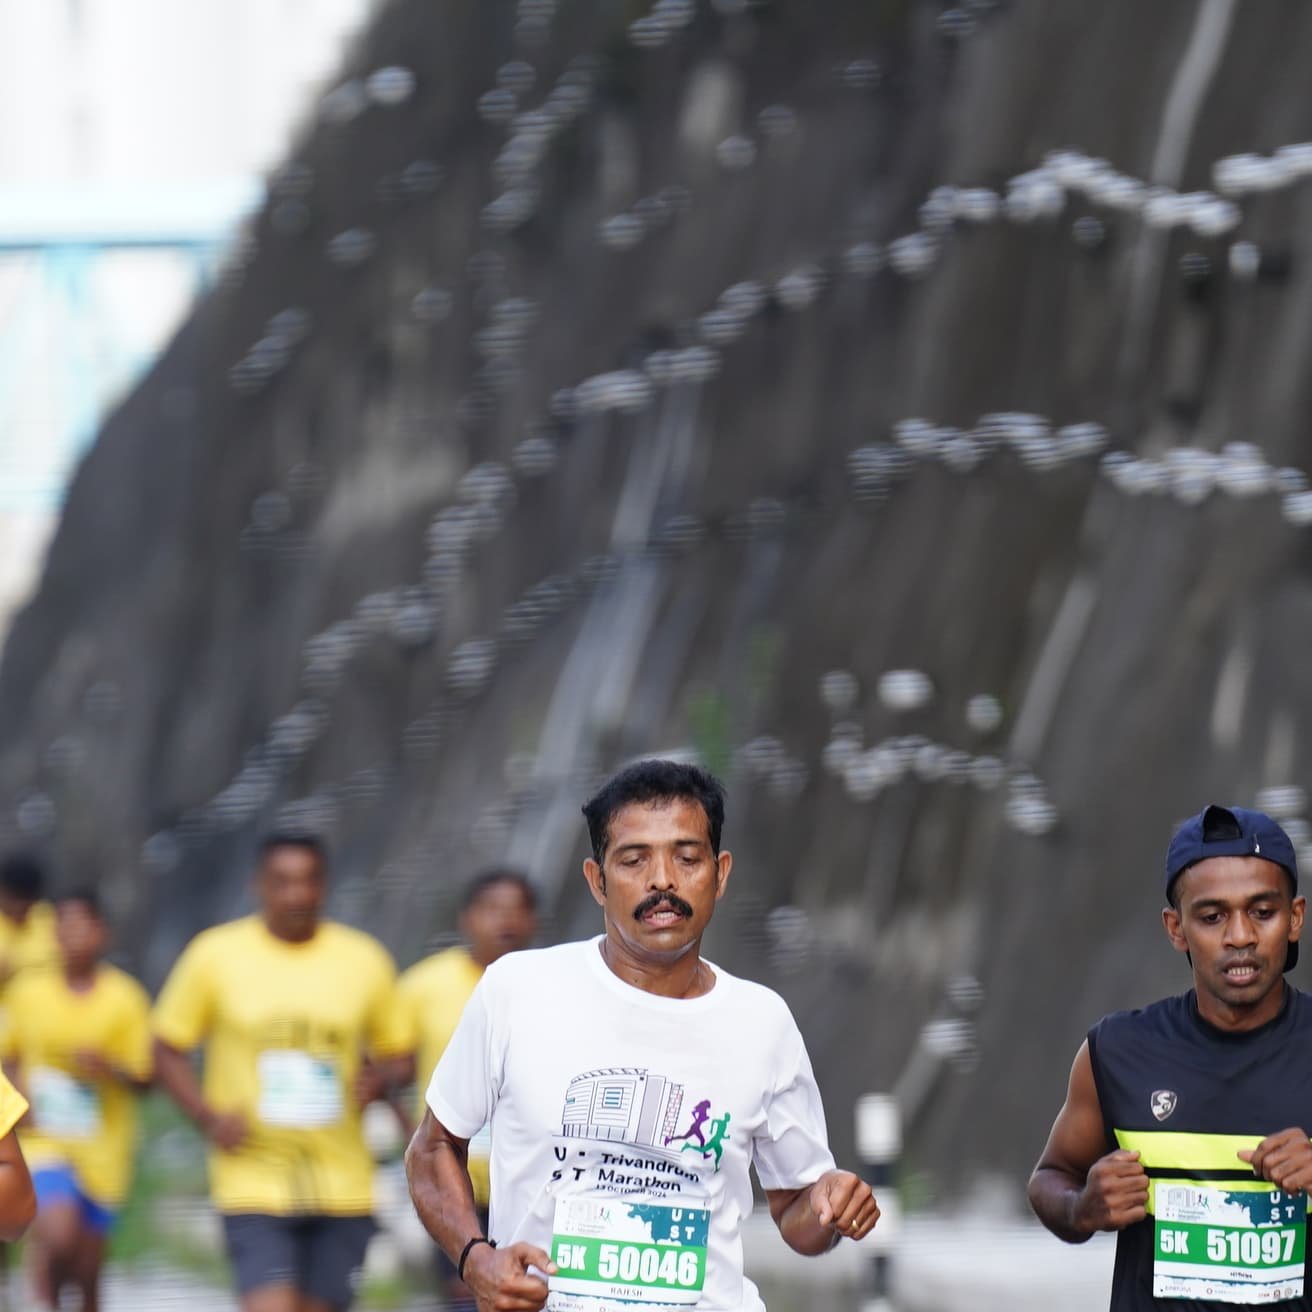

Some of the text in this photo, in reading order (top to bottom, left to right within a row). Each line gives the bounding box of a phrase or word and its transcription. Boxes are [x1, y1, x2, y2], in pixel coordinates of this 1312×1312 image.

[554, 1146, 568, 1162] U
[600, 1152, 700, 1184] Trivandrum
[597, 1169, 682, 1193] Marathon
[670, 1208, 684, 1223] U
[1160, 1229, 1297, 1265] 5K 51097
[556, 1243, 698, 1287] 5K 50046
